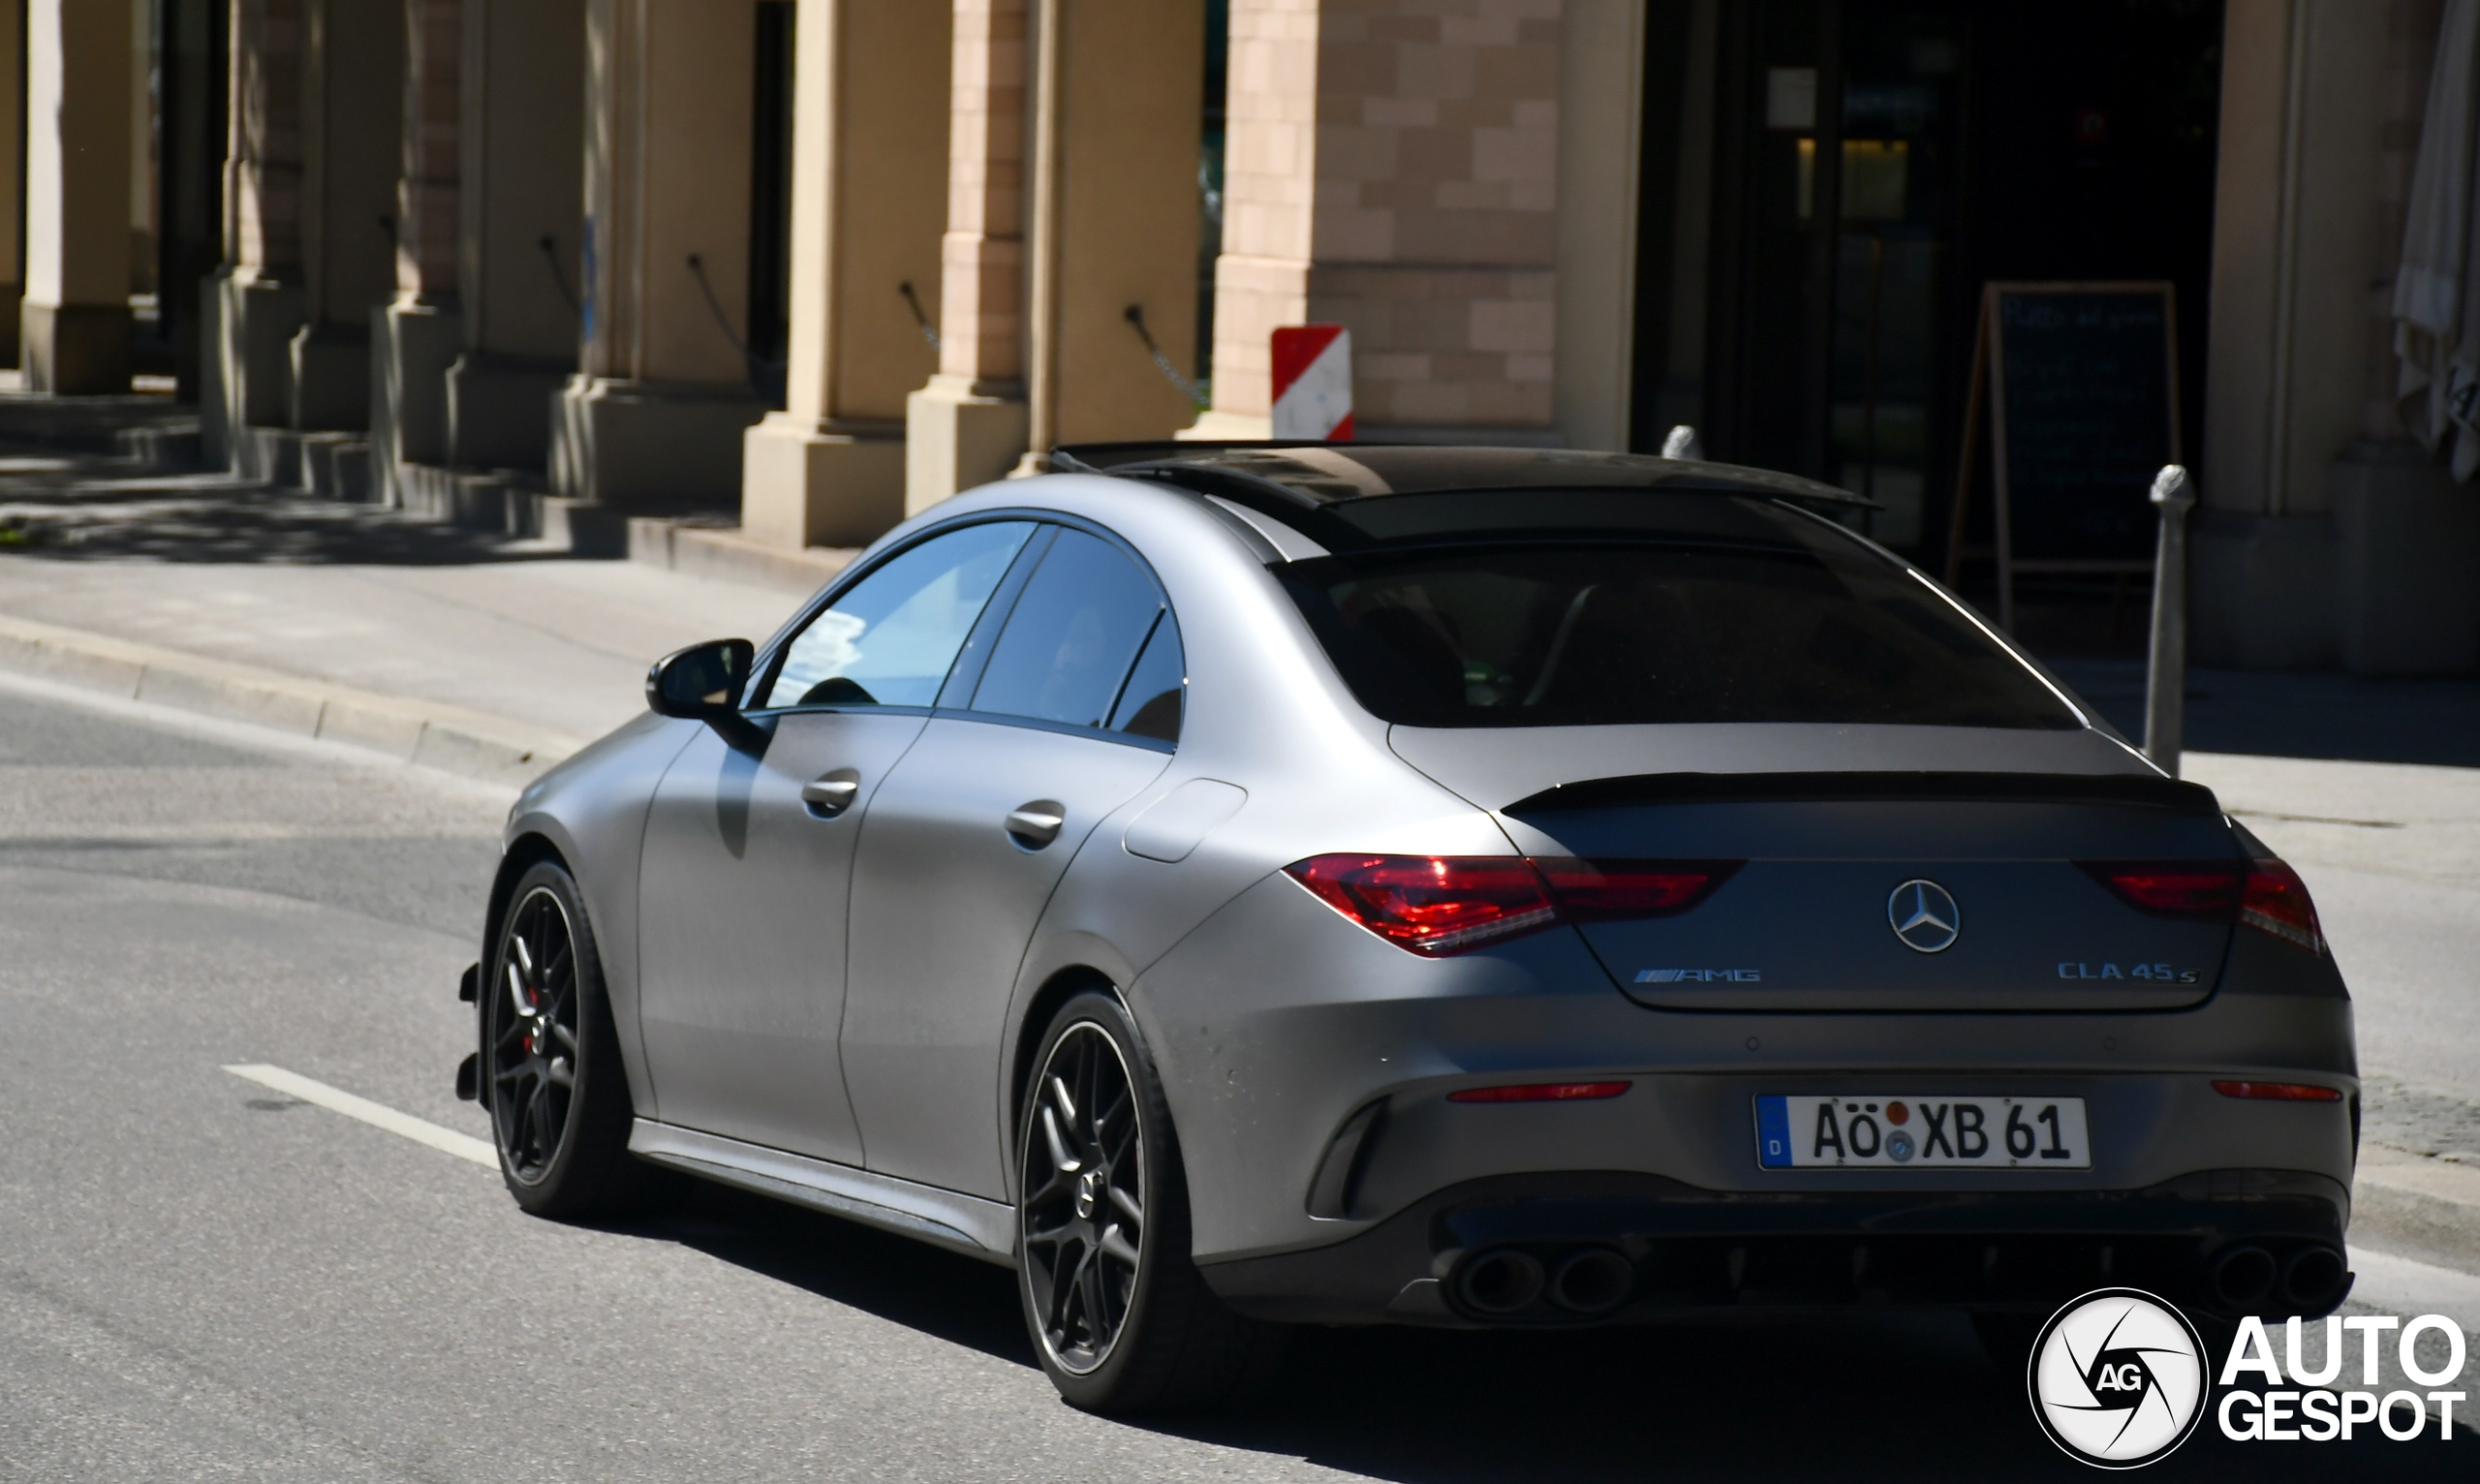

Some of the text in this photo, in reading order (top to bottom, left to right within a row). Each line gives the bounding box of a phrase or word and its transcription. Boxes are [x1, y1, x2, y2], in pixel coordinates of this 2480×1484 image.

[1674, 969, 1761, 982] AMG
[2058, 963, 2124, 979] CLA
[2131, 963, 2174, 979] 45
[1814, 1103, 2071, 1159] AÖ XB 61
[1769, 1139, 1782, 1156] D
